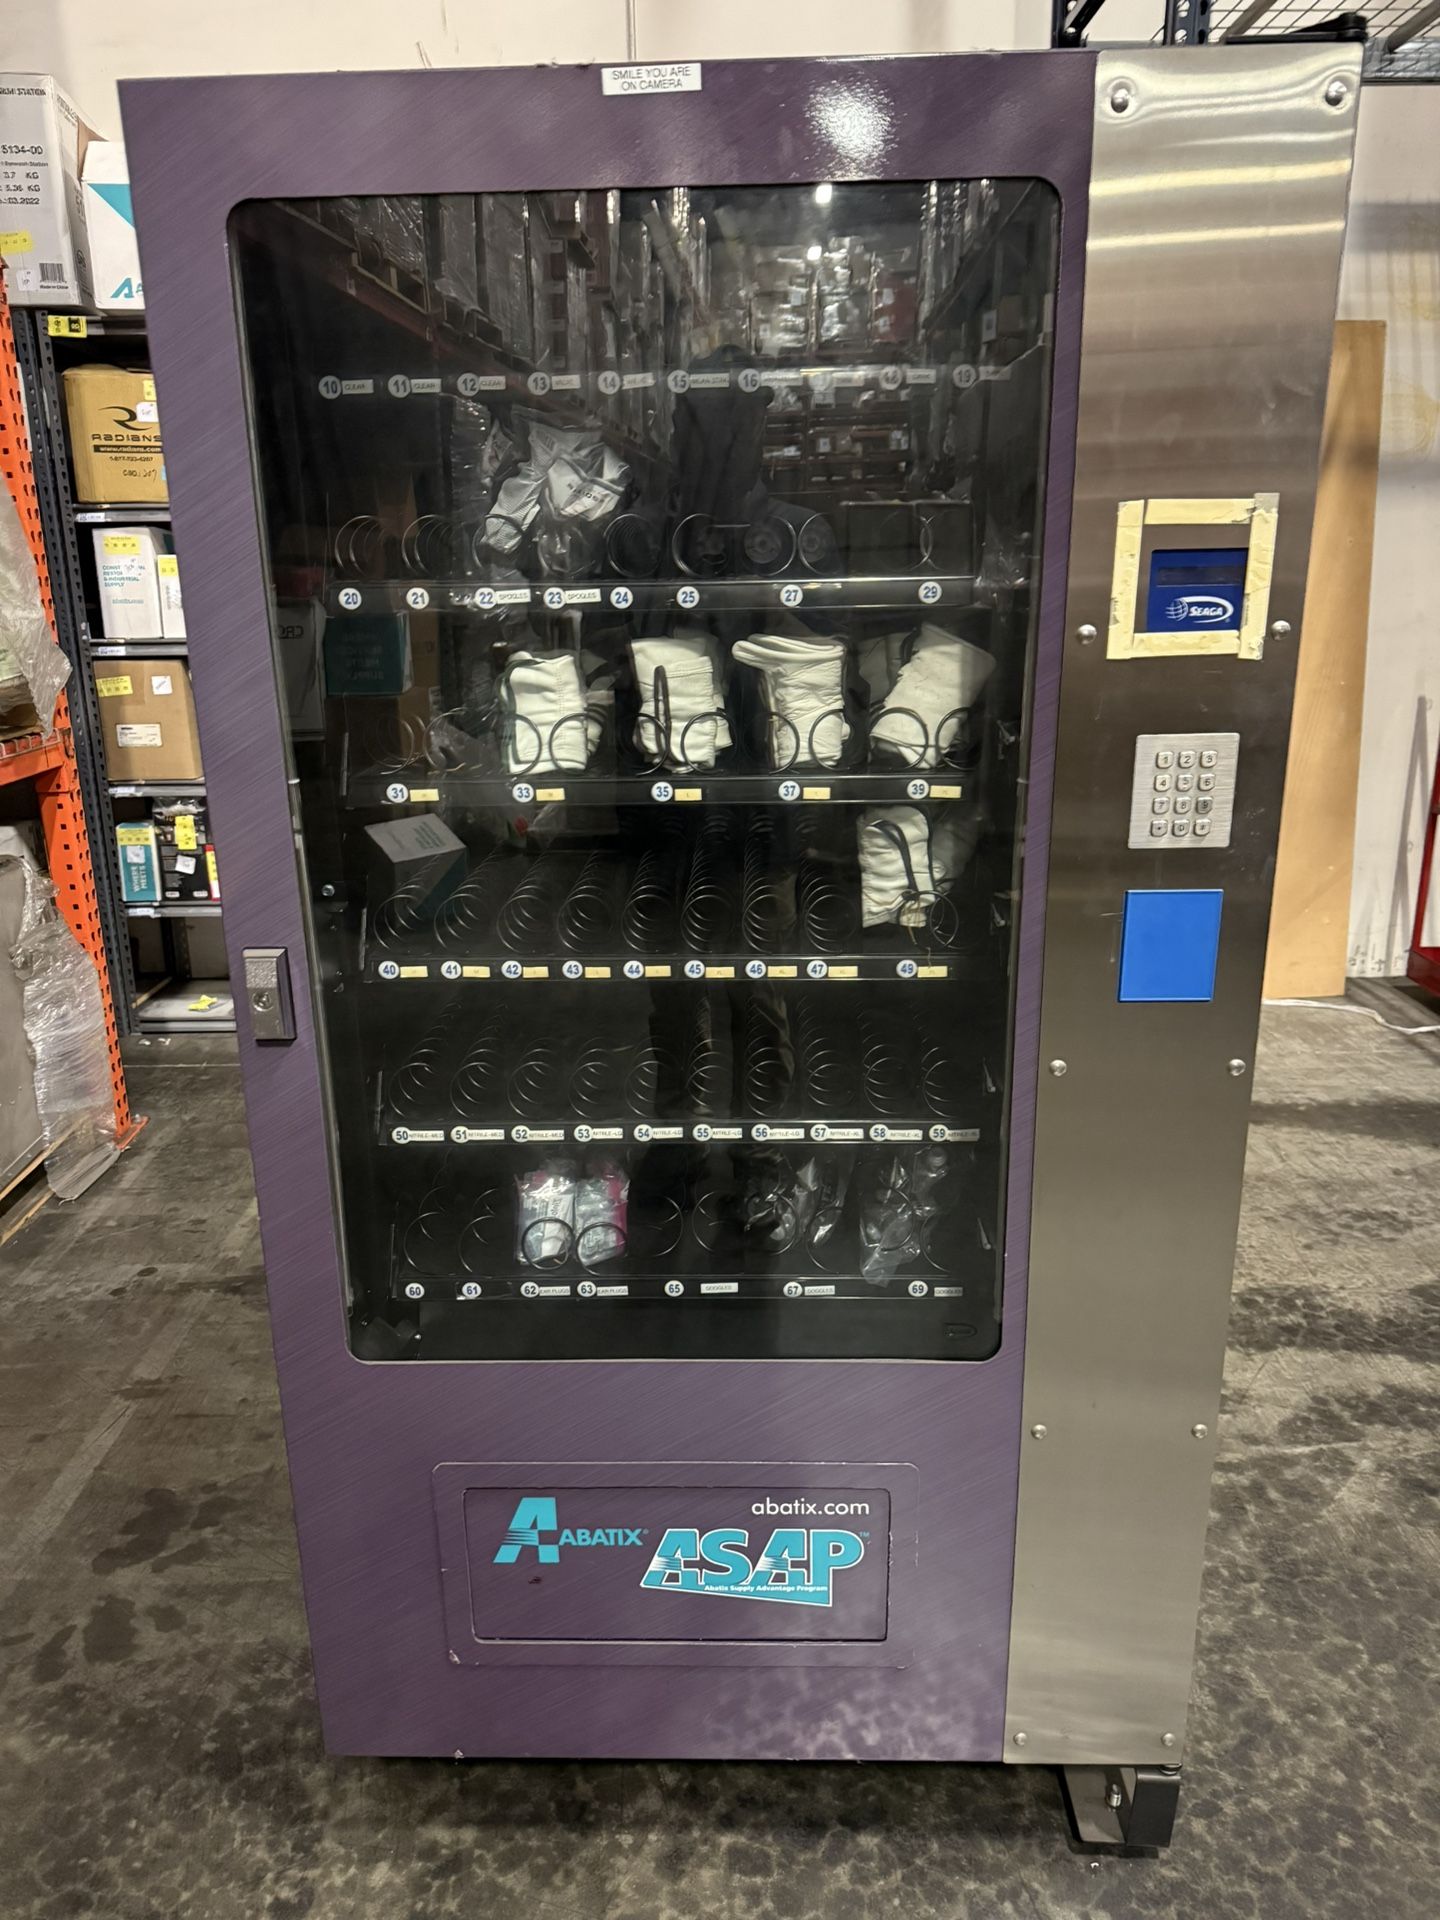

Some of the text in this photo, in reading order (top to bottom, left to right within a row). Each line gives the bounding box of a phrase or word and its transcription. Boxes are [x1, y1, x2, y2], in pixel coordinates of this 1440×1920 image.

[612, 66, 692, 80] SMILE YOU ARE
[622, 79, 683, 91] ON CAMERA
[393, 379, 407, 393] 11
[462, 378, 477, 392] 12
[533, 377, 547, 391] 13
[603, 376, 617, 389] 14
[672, 375, 687, 389] 15
[743, 374, 758, 388] 16
[323, 380, 338, 394] 10
[548, 592, 562, 604] 23
[615, 592, 629, 604] 24
[682, 591, 695, 604] 25
[785, 589, 799, 602] 27
[923, 586, 938, 599] 29
[344, 592, 358, 605] 20
[412, 592, 425, 605] 21
[479, 592, 493, 605] 22
[1189, 606, 1223, 616] SEAGA
[392, 787, 404, 799] 31
[517, 787, 530, 798] 33
[656, 786, 669, 798] 35
[783, 785, 796, 797] 37
[912, 784, 925, 795] 39
[383, 965, 396, 975] 40
[446, 965, 458, 975] 41
[506, 964, 519, 975] 42
[567, 964, 579, 975] 43
[628, 965, 640, 975] 44
[688, 964, 701, 975] 45
[750, 964, 763, 975] 46
[811, 964, 824, 974] 47
[396, 1130, 408, 1141] 50
[455, 1130, 467, 1140] 51
[515, 1129, 528, 1139] 52
[578, 1129, 590, 1139] 53
[638, 1128, 650, 1138] 54
[697, 1128, 709, 1138] 55
[755, 1127, 767, 1138] 56
[814, 1128, 826, 1138] 57
[874, 1128, 886, 1138] 58
[933, 1128, 946, 1139] 59
[409, 1287, 421, 1296] 60
[466, 1286, 478, 1295] 61
[524, 1285, 536, 1294] 62
[581, 1285, 593, 1294] 63
[668, 1284, 680, 1293] 65
[787, 1286, 798, 1294] 67
[912, 1284, 924, 1294] 69
[751, 1497, 870, 1516] abatix.com
